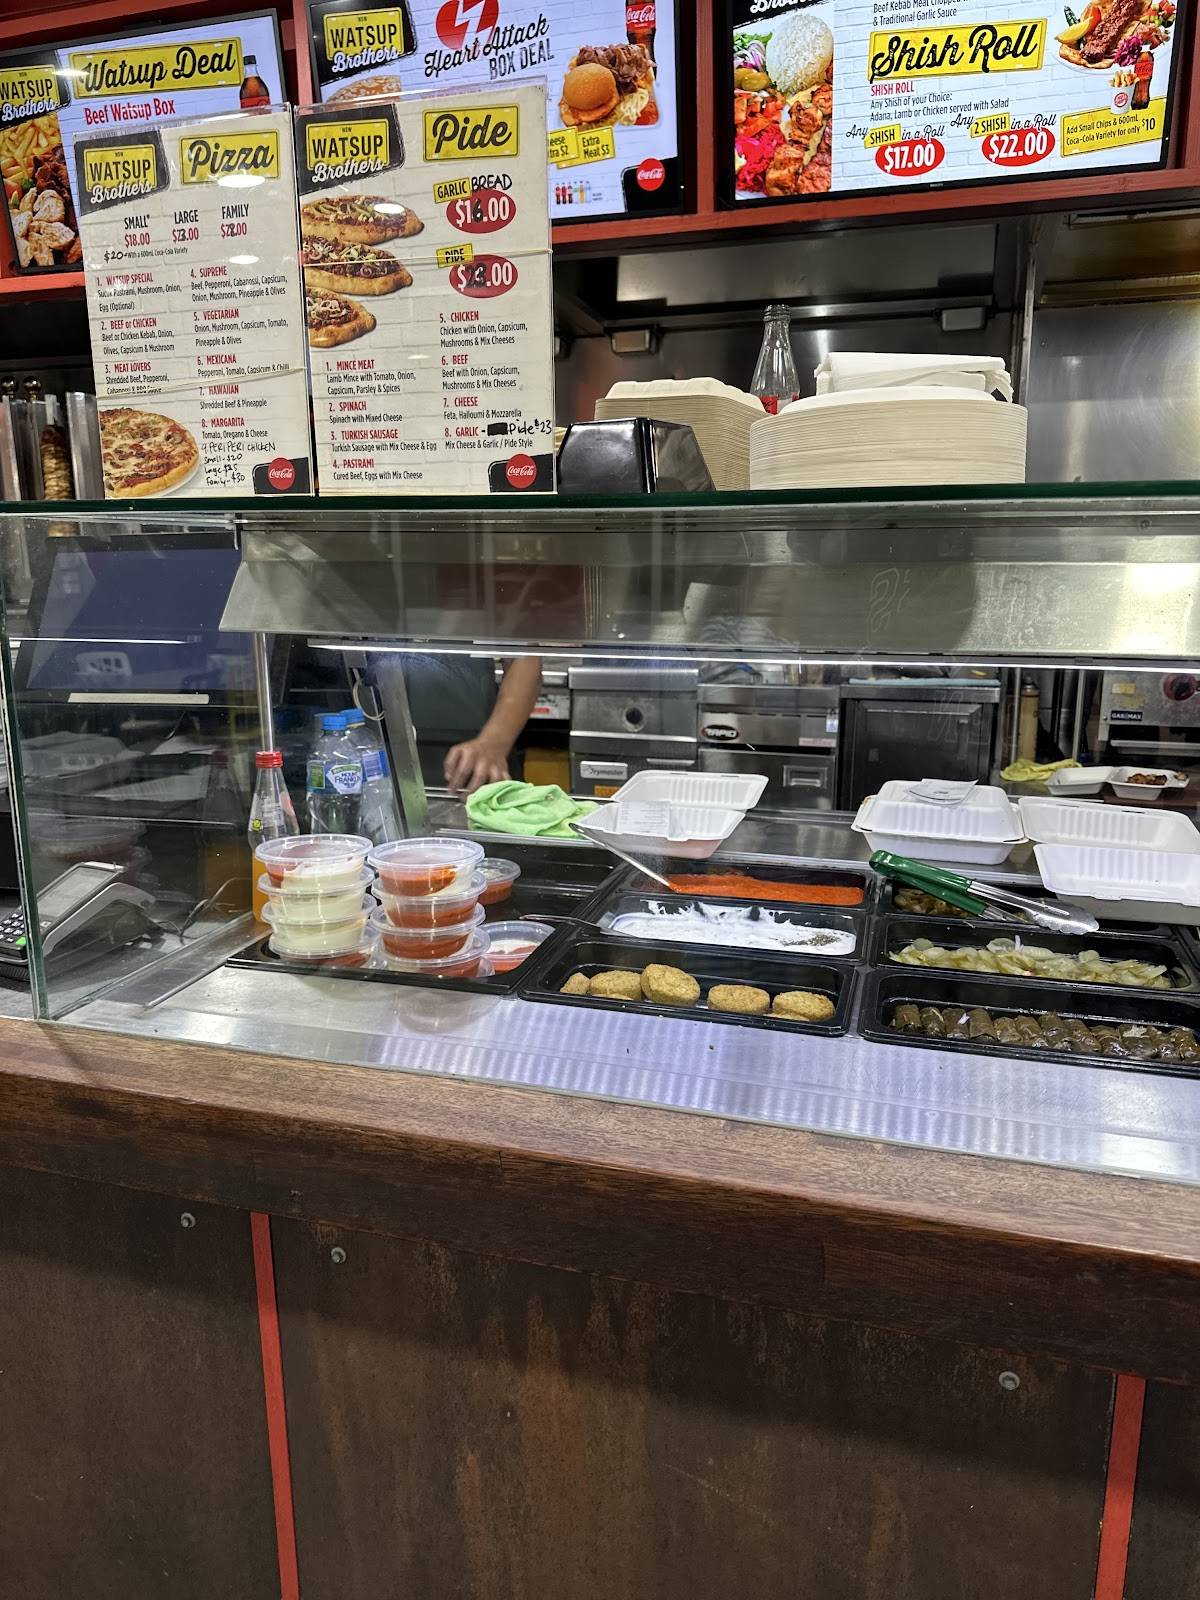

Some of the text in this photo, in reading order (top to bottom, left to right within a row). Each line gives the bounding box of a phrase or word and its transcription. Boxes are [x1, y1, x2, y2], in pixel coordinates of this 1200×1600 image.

[873, 1, 890, 14] Beef
[890, 0, 912, 11] Kebab
[873, 8, 958, 26] & Traditional Garlic Sauce
[330, 24, 397, 49] WATSUP
[424, 13, 549, 78] Heart Attack
[331, 45, 399, 73] Brothers
[489, 38, 555, 80] BOX DEAL
[869, 23, 1038, 84] Shish Roll
[79, 43, 236, 93] Watsup Deal
[0, 78, 53, 101] WATSUP
[870, 81, 915, 97] SHISH ROLL
[1, 99, 56, 122] Brothers
[870, 92, 953, 111] Any Shish of your Choice:
[870, 98, 1009, 123] Adana, Lamb or Chicken served with Salad
[85, 98, 175, 125] Beef Watsup Box
[950, 113, 1056, 135] Any 2 SHISH in a Roll
[1066, 114, 1139, 135] Add Small Chips & 600mL
[1066, 117, 1156, 147] Coca-Cola Variety for only $10
[432, 113, 512, 154] Pide
[582, 136, 600, 146] Extra
[846, 123, 945, 145] Any SHISH in a Roll
[312, 134, 384, 160] WATSUP
[560, 145, 568, 156] $2
[584, 144, 610, 159] Meat $3
[989, 131, 1048, 164] $22.00
[188, 139, 275, 177] Pizza
[884, 143, 935, 173] $17.00
[90, 159, 152, 182] WATSUP
[312, 156, 386, 183] Brothers
[438, 181, 468, 199] GARLIC
[471, 174, 512, 192] BREAD
[90, 180, 152, 205] Brothers
[174, 210, 199, 225] LARGE
[221, 204, 250, 219] FAMILY
[124, 232, 150, 249] $18.00
[445, 248, 465, 263] PIDE
[131, 272, 153, 284] SPECIAL
[191, 266, 228, 278] 4. SUPREME
[193, 308, 240, 321] 5. VEGETARIAN
[440, 310, 479, 323] 5. CHICKEN
[101, 317, 157, 331] 2. BEEF or CHICKEN
[440, 322, 528, 335] Chicken with Onion, Capsicum,
[440, 335, 515, 348] Mushrooms & Mix Cheeses
[105, 361, 152, 374] 3. MEAT LOVERS
[197, 354, 236, 366] 6. MEXICANA
[326, 359, 375, 371] 1. MINCE MEAT
[441, 354, 469, 365] 6. BEEF
[208, 384, 239, 396] HAWAIIAN
[329, 401, 367, 412] 2. SPINACH
[443, 396, 479, 408] 7. CHEESE
[201, 417, 245, 428] 8. MARGARITA
[444, 426, 479, 437] 8. GARLIC
[202, 429, 269, 440] Tomato, Oregano & Cheese
[331, 429, 399, 440] 3. TURKISH SAUSAGE
[332, 459, 374, 469] 4. PASTRAMI
